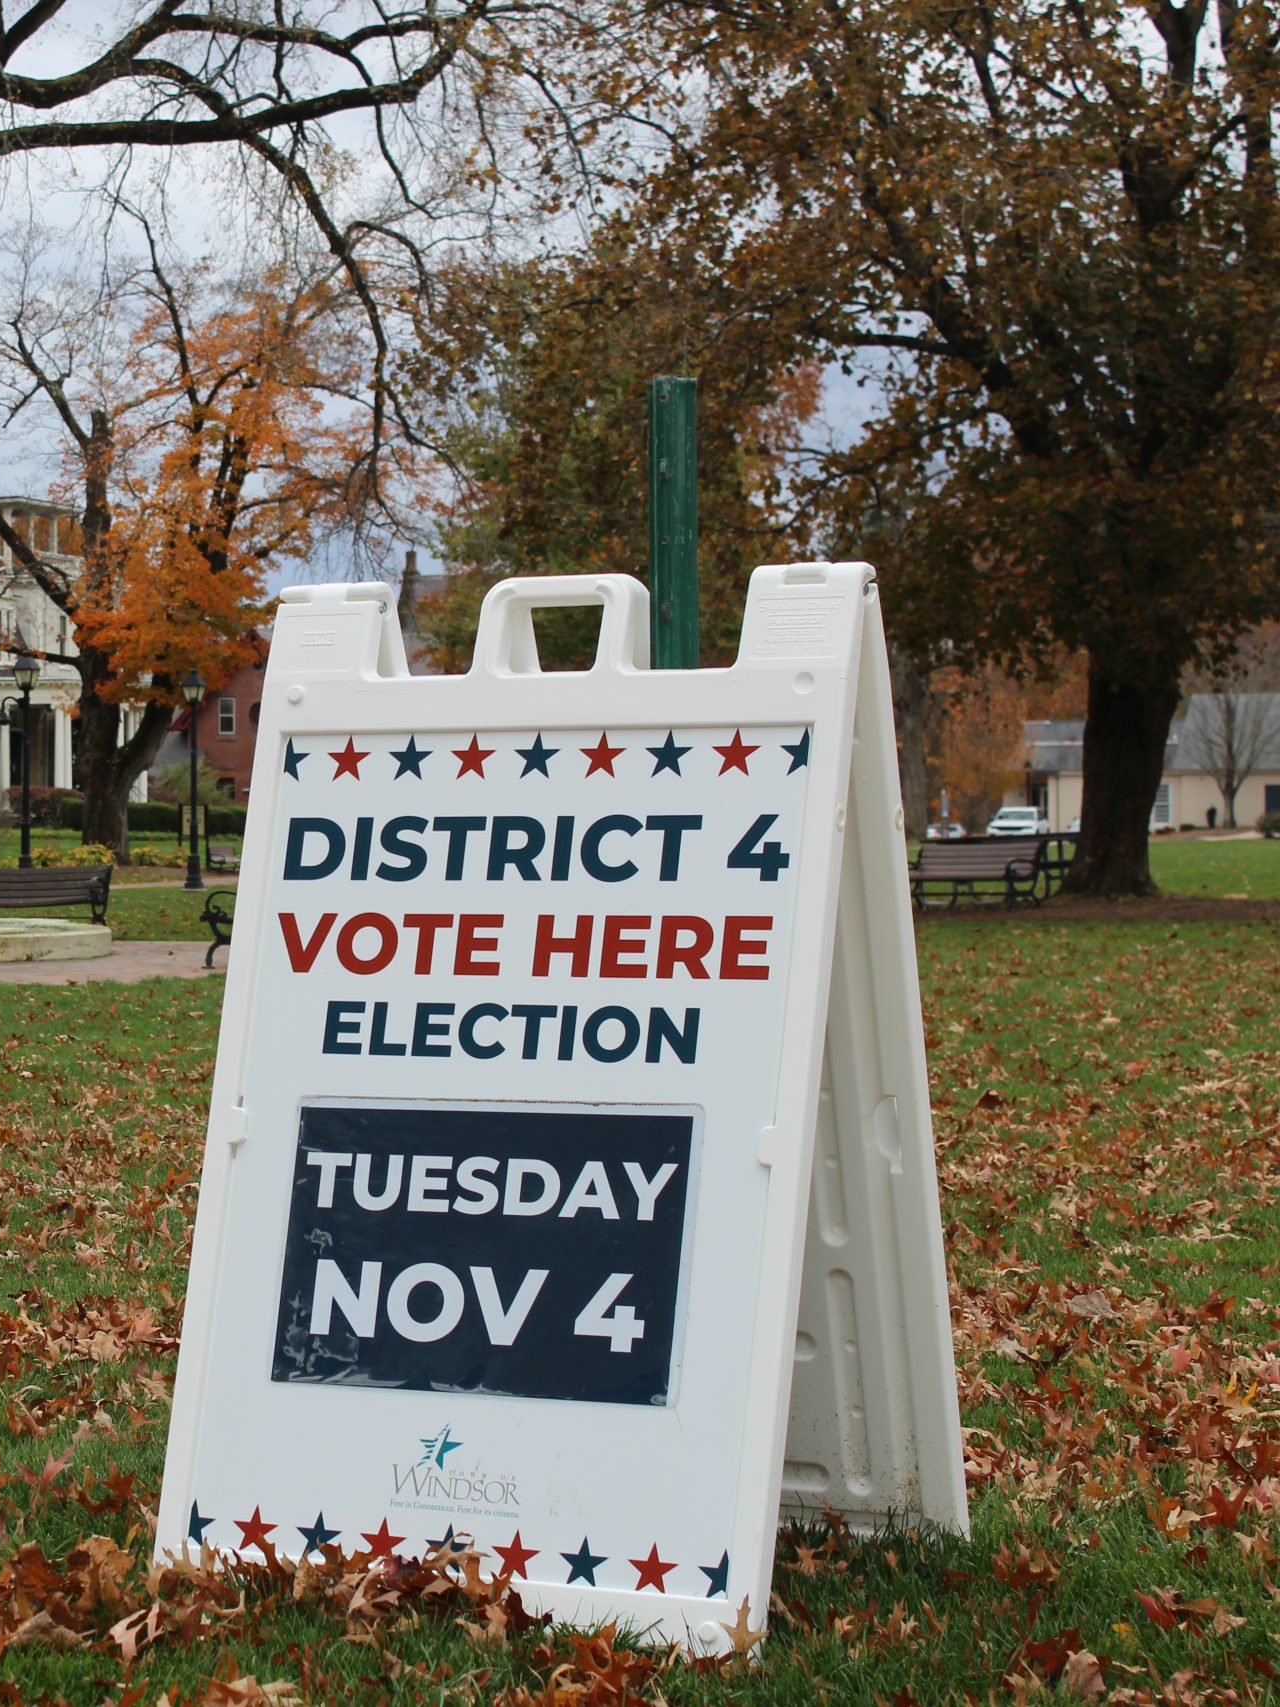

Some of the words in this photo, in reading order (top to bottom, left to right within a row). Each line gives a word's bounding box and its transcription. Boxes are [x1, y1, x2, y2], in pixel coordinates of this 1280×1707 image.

[283, 814, 703, 882] DISTRICT
[727, 814, 790, 881] 4
[278, 912, 504, 976] VOTE
[532, 915, 773, 980] HERE
[322, 1001, 700, 1064] ELECTION
[307, 1152, 678, 1220] TUESDAY
[310, 1260, 549, 1345] NOV
[574, 1274, 644, 1352] 4
[392, 1463, 520, 1506] WINDSOR
[448, 1470, 487, 1479] TOWN
[390, 1498, 404, 1508] First
[405, 1500, 412, 1508] in
[413, 1501, 455, 1513] Connecticut.
[457, 1504, 471, 1514] First
[472, 1506, 482, 1516] for
[493, 1509, 520, 1519] citizens.
